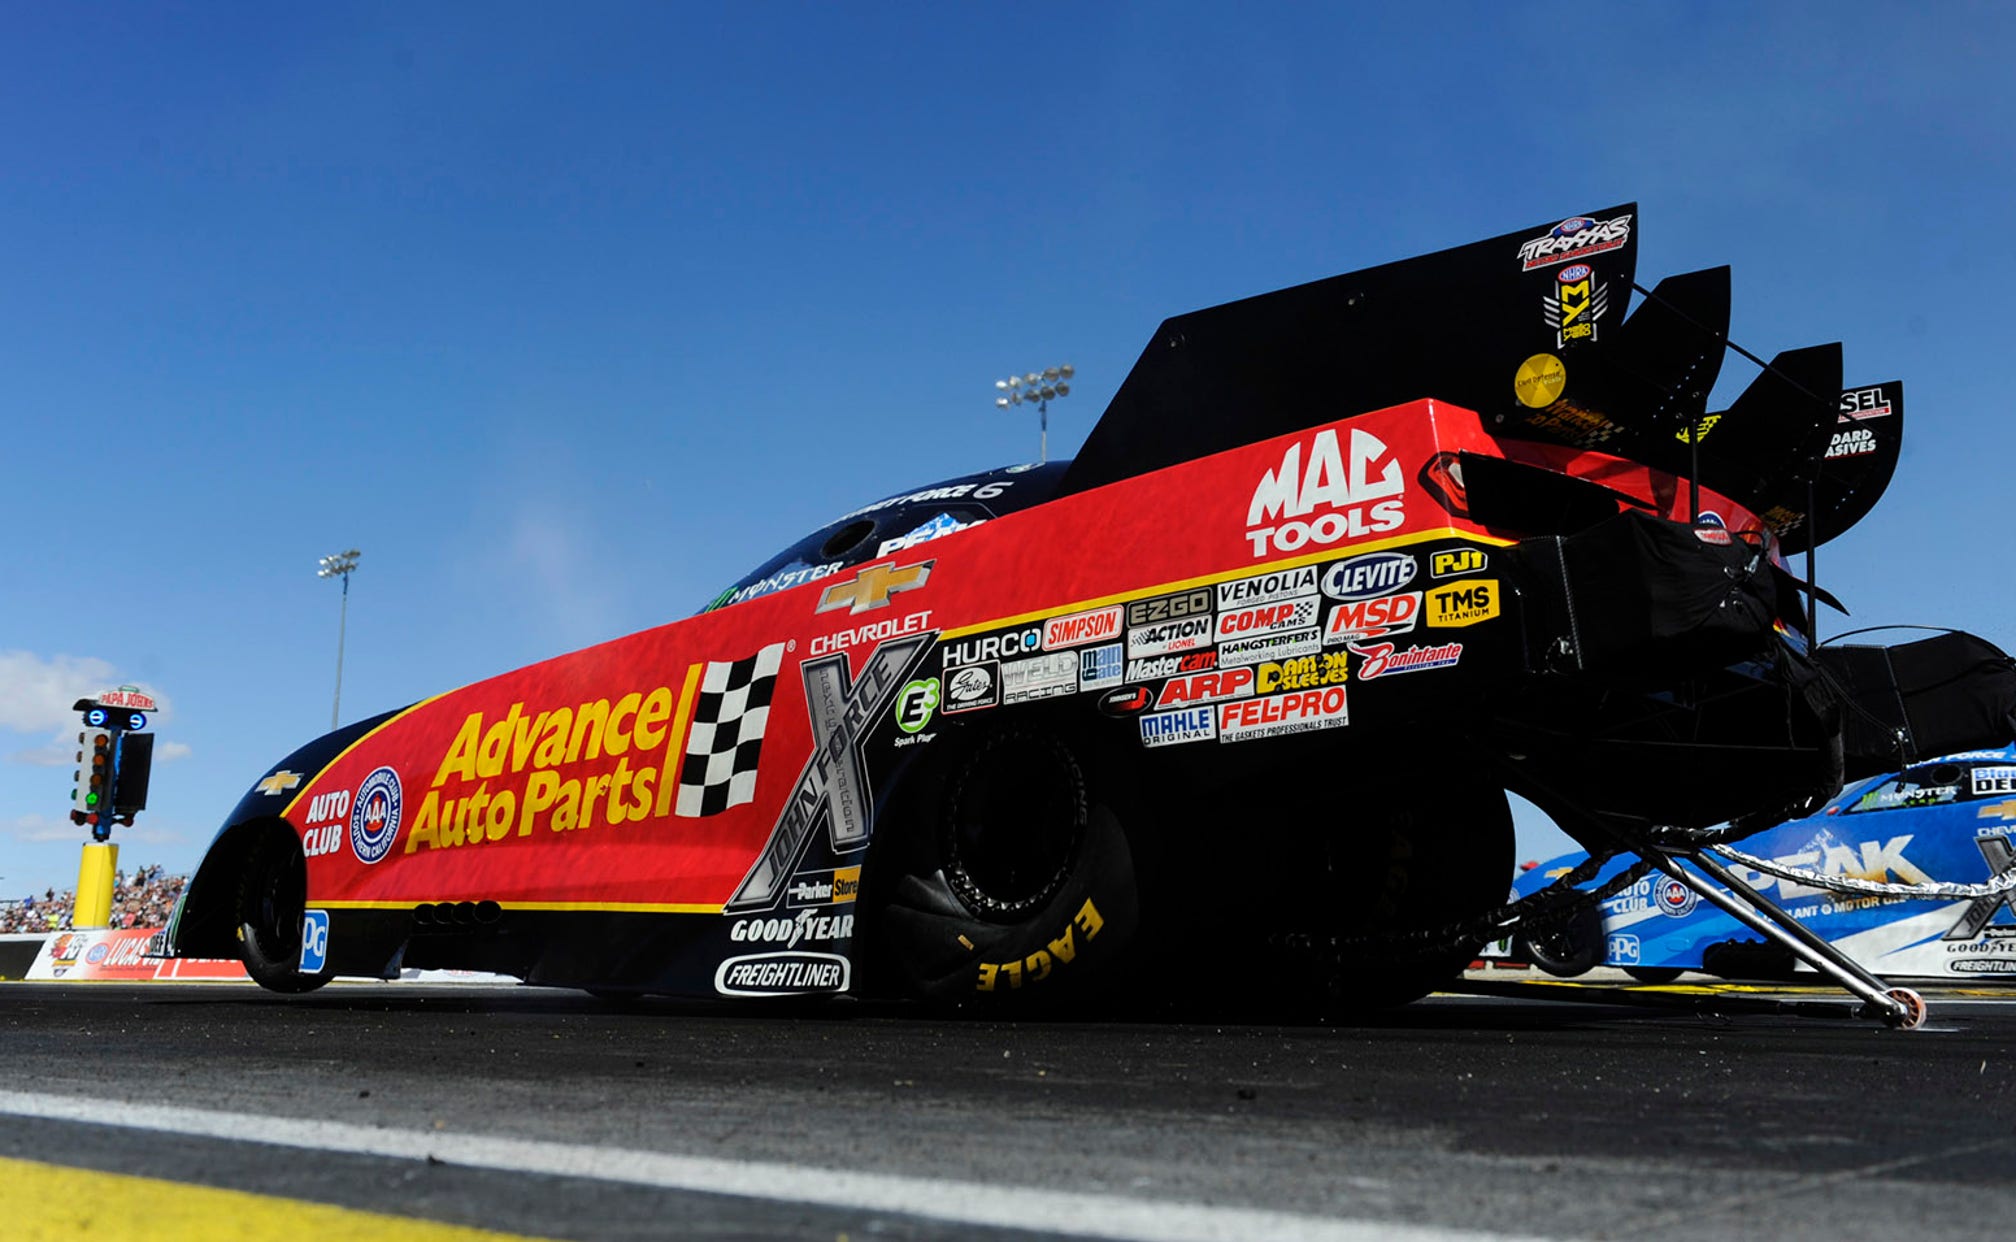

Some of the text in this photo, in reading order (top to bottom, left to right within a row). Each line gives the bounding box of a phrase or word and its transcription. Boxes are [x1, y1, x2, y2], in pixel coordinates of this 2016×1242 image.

[1519, 215, 1631, 260] TRAXXAS
[1560, 266, 1590, 281] NHRA
[973, 481, 1014, 499] 6
[1246, 428, 1405, 527] MAC
[1246, 500, 1405, 558] TOOLS
[1325, 555, 1415, 594] CLEVITE
[1435, 550, 1482, 575] PJ1
[1221, 568, 1315, 602] VENOLIA
[1130, 593, 1209, 622] EZGO
[1332, 594, 1417, 633] MSD
[1435, 586, 1490, 613] TMS
[1049, 610, 1118, 644] SIMPSON
[1220, 604, 1295, 635] COMP
[1270, 617, 1306, 630] CAMS
[1438, 607, 1490, 622] TITANIUM
[811, 610, 932, 655] CHEVROLET
[1146, 619, 1208, 645] ACTION
[1167, 638, 1196, 651] LIONEL
[1222, 630, 1318, 655] HANGSTERFER'S
[942, 627, 1041, 667] HURCO
[1221, 644, 1320, 666] Metalworking Lubricants
[1003, 652, 1077, 684] WELD
[1126, 651, 1216, 681] Mastercam
[1005, 684, 1076, 703] RACING
[1159, 668, 1252, 705] ARP
[1142, 709, 1210, 737] MAHLE
[1221, 687, 1345, 731] FEL-PRO
[431, 686, 672, 787] Advance
[1144, 729, 1210, 746] ORIGINAL
[1222, 716, 1347, 743] THE GASKETS PROFESSIONALS TRUST
[306, 789, 350, 825] AUTO
[364, 801, 387, 824] AAA
[405, 757, 656, 854] Auto Parts
[302, 824, 342, 858] CLUB
[1616, 880, 1650, 897] UTO
[1666, 888, 1685, 899] AAA
[1613, 897, 1648, 913] CLUB
[1834, 896, 1880, 913] MOTOR
[731, 912, 854, 943] GOODYEAR
[976, 897, 1104, 991] EAGLE
[1608, 937, 1638, 962] PPG
[728, 964, 841, 987] FREIGHTLINER
